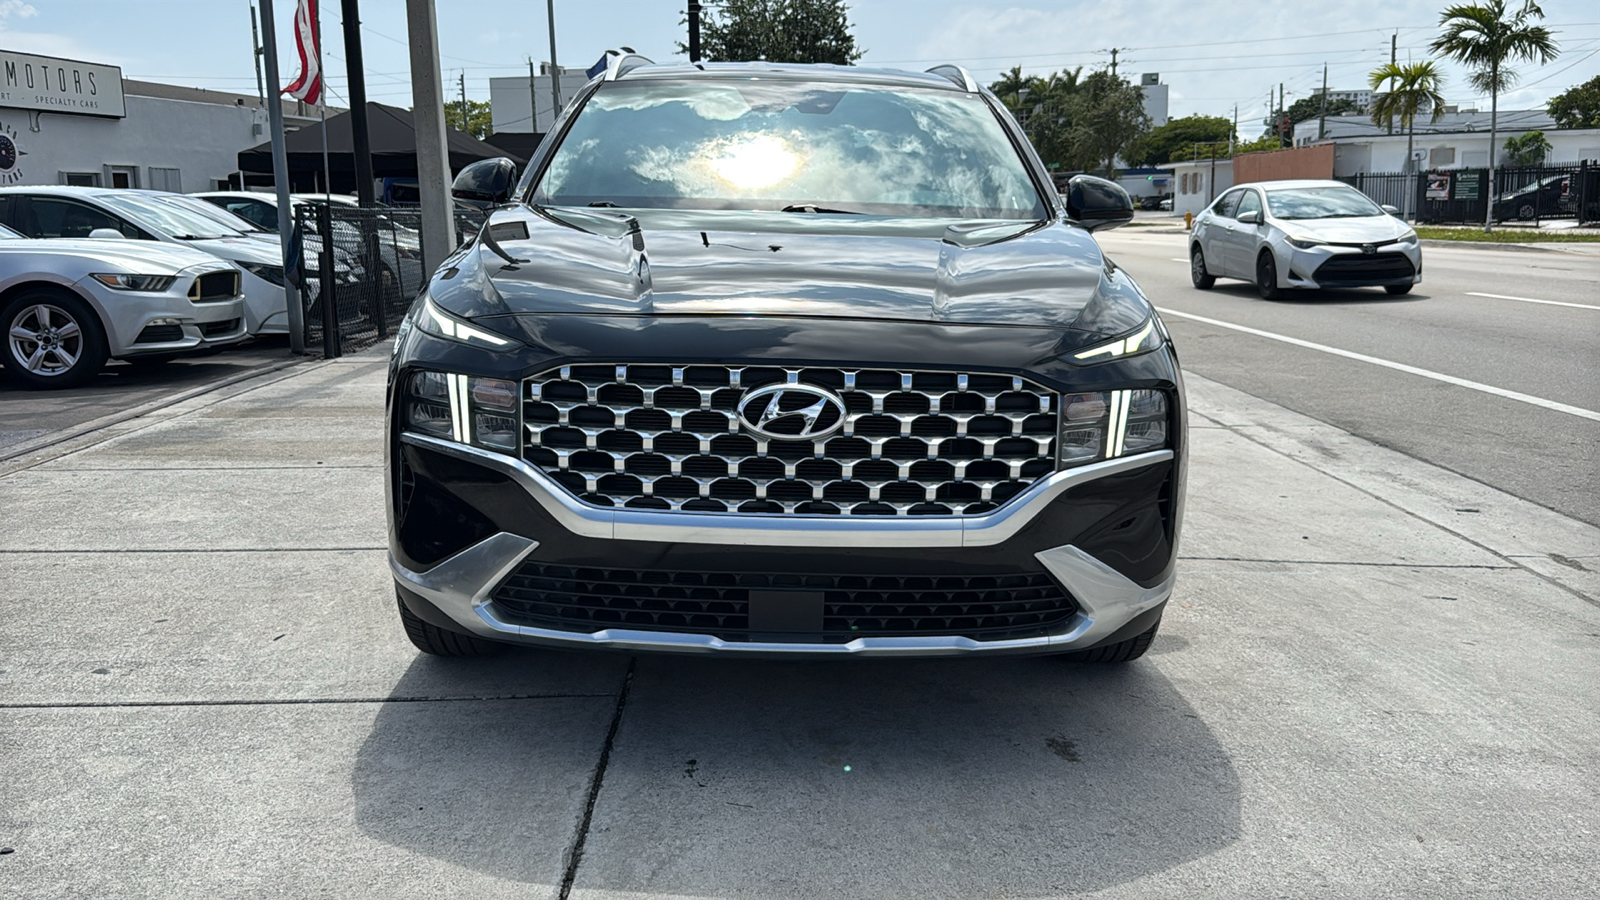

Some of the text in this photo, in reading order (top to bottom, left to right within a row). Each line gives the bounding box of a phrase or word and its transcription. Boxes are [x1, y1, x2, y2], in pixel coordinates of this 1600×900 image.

[5, 60, 97, 96] MOTORS
[35, 95, 77, 107] SPECIALTY
[79, 100, 99, 109] CARS
